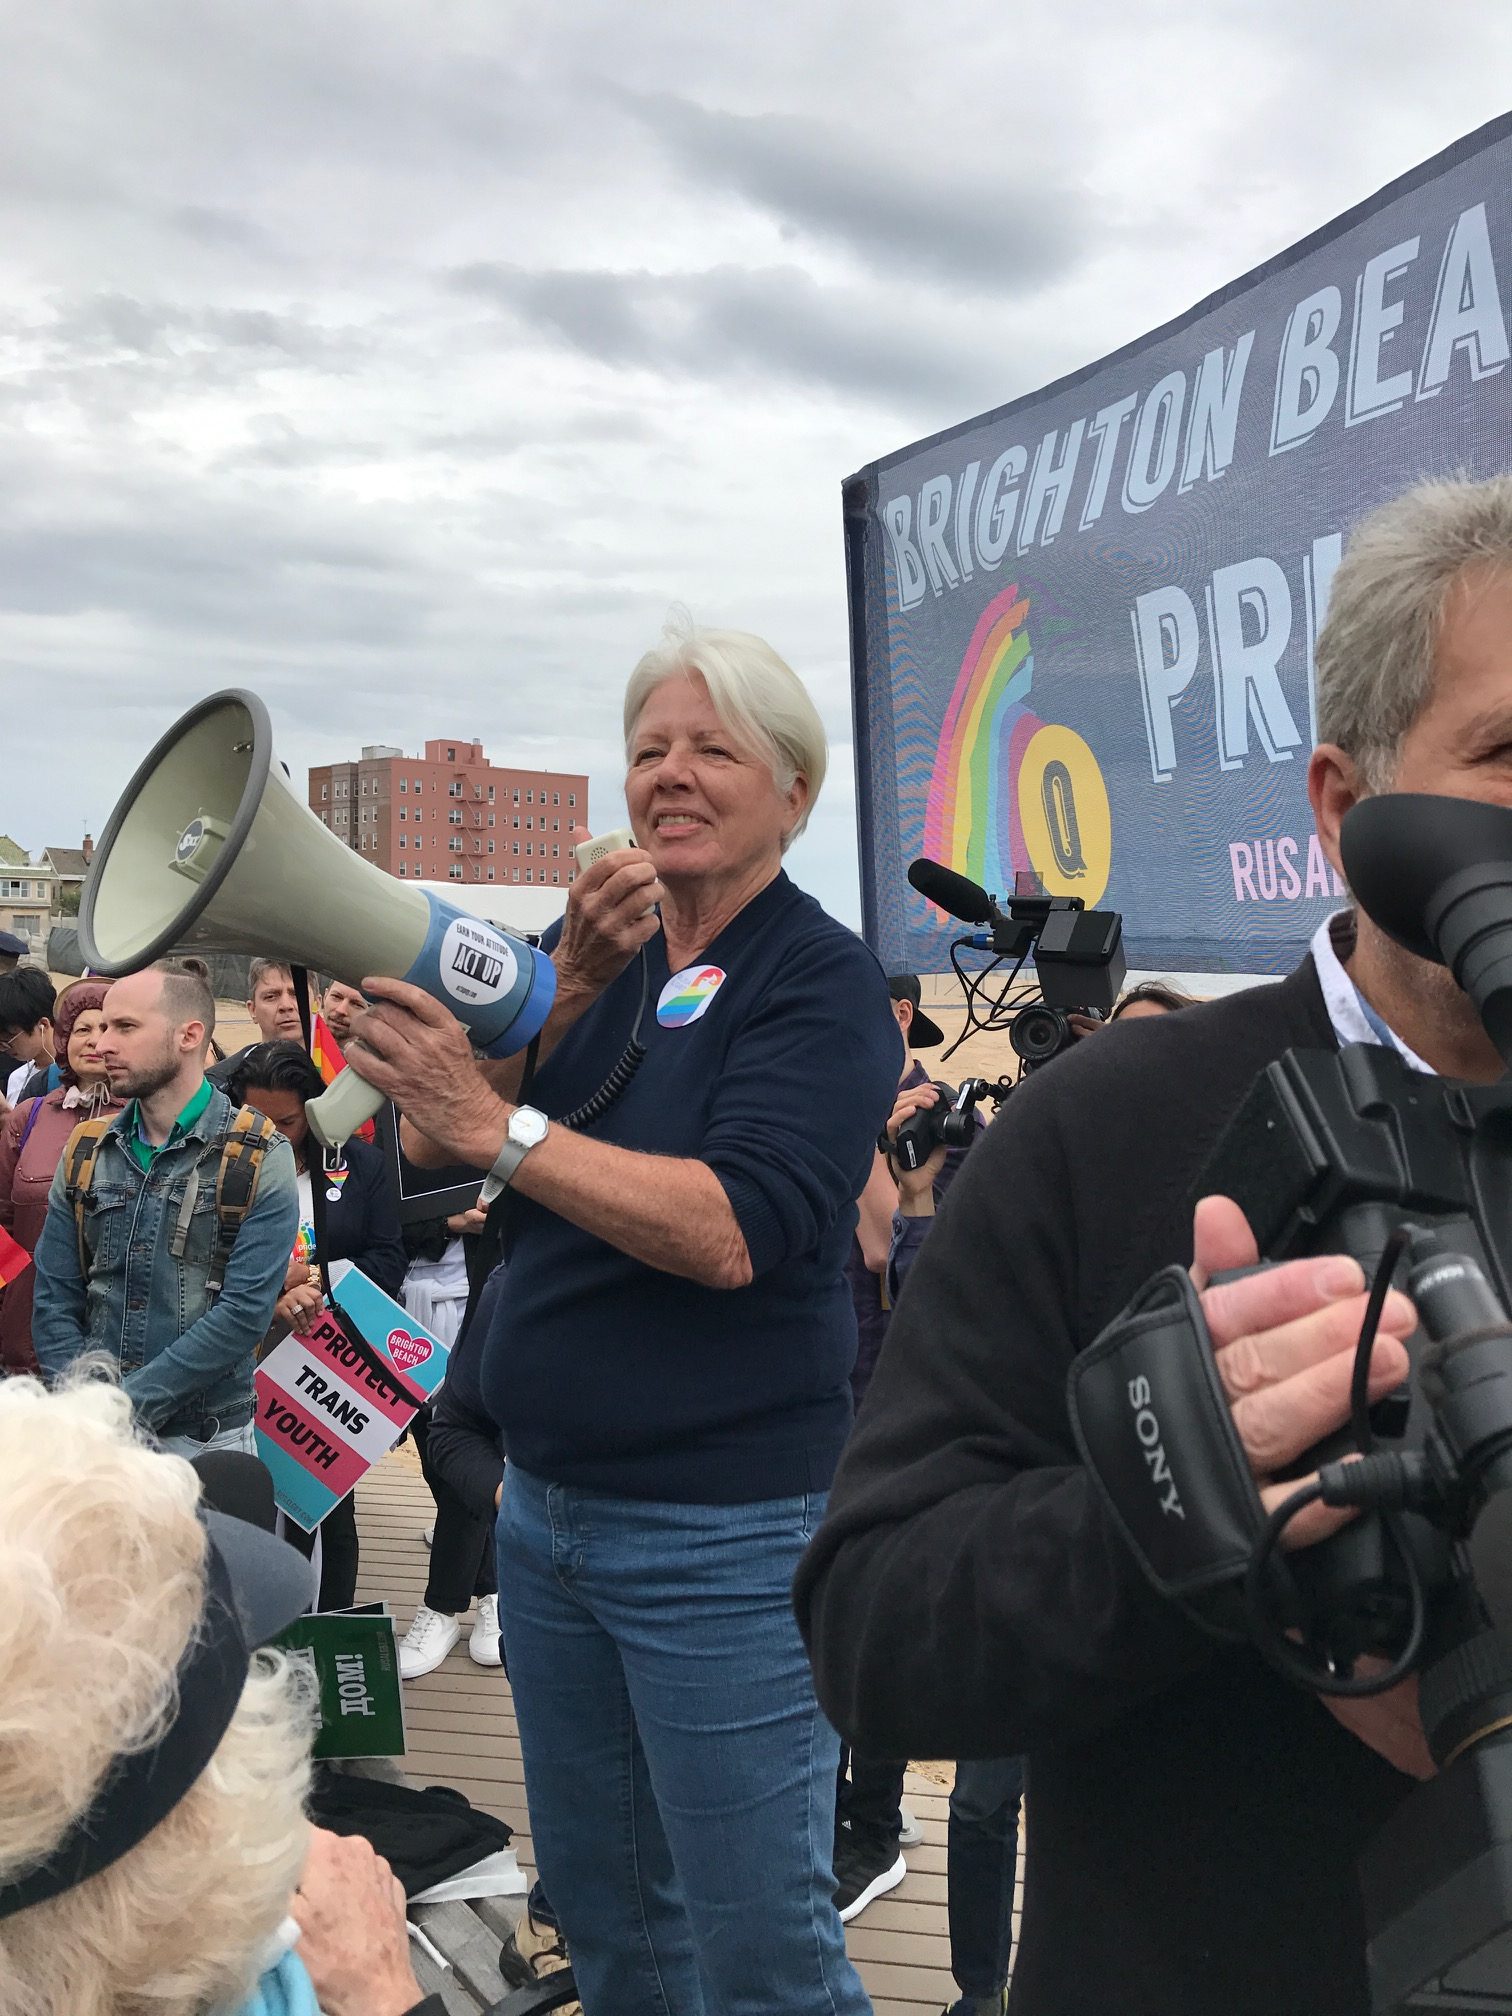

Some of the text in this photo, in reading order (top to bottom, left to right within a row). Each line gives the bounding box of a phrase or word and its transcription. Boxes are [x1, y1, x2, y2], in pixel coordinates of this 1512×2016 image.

[881, 329, 1256, 613] BRIGHTON
[1040, 760, 1088, 880] Q
[453, 944, 502, 985] ACT UP
[471, 930, 486, 946] YOUR
[390, 1334, 430, 1358] BRIGHTON
[393, 1348, 419, 1366] BEACH
[294, 1364, 370, 1435] TRANS
[262, 1397, 341, 1471] YOUTH
[1127, 1375, 1186, 1521] SONY
[334, 1653, 377, 1716] ДОМ!
